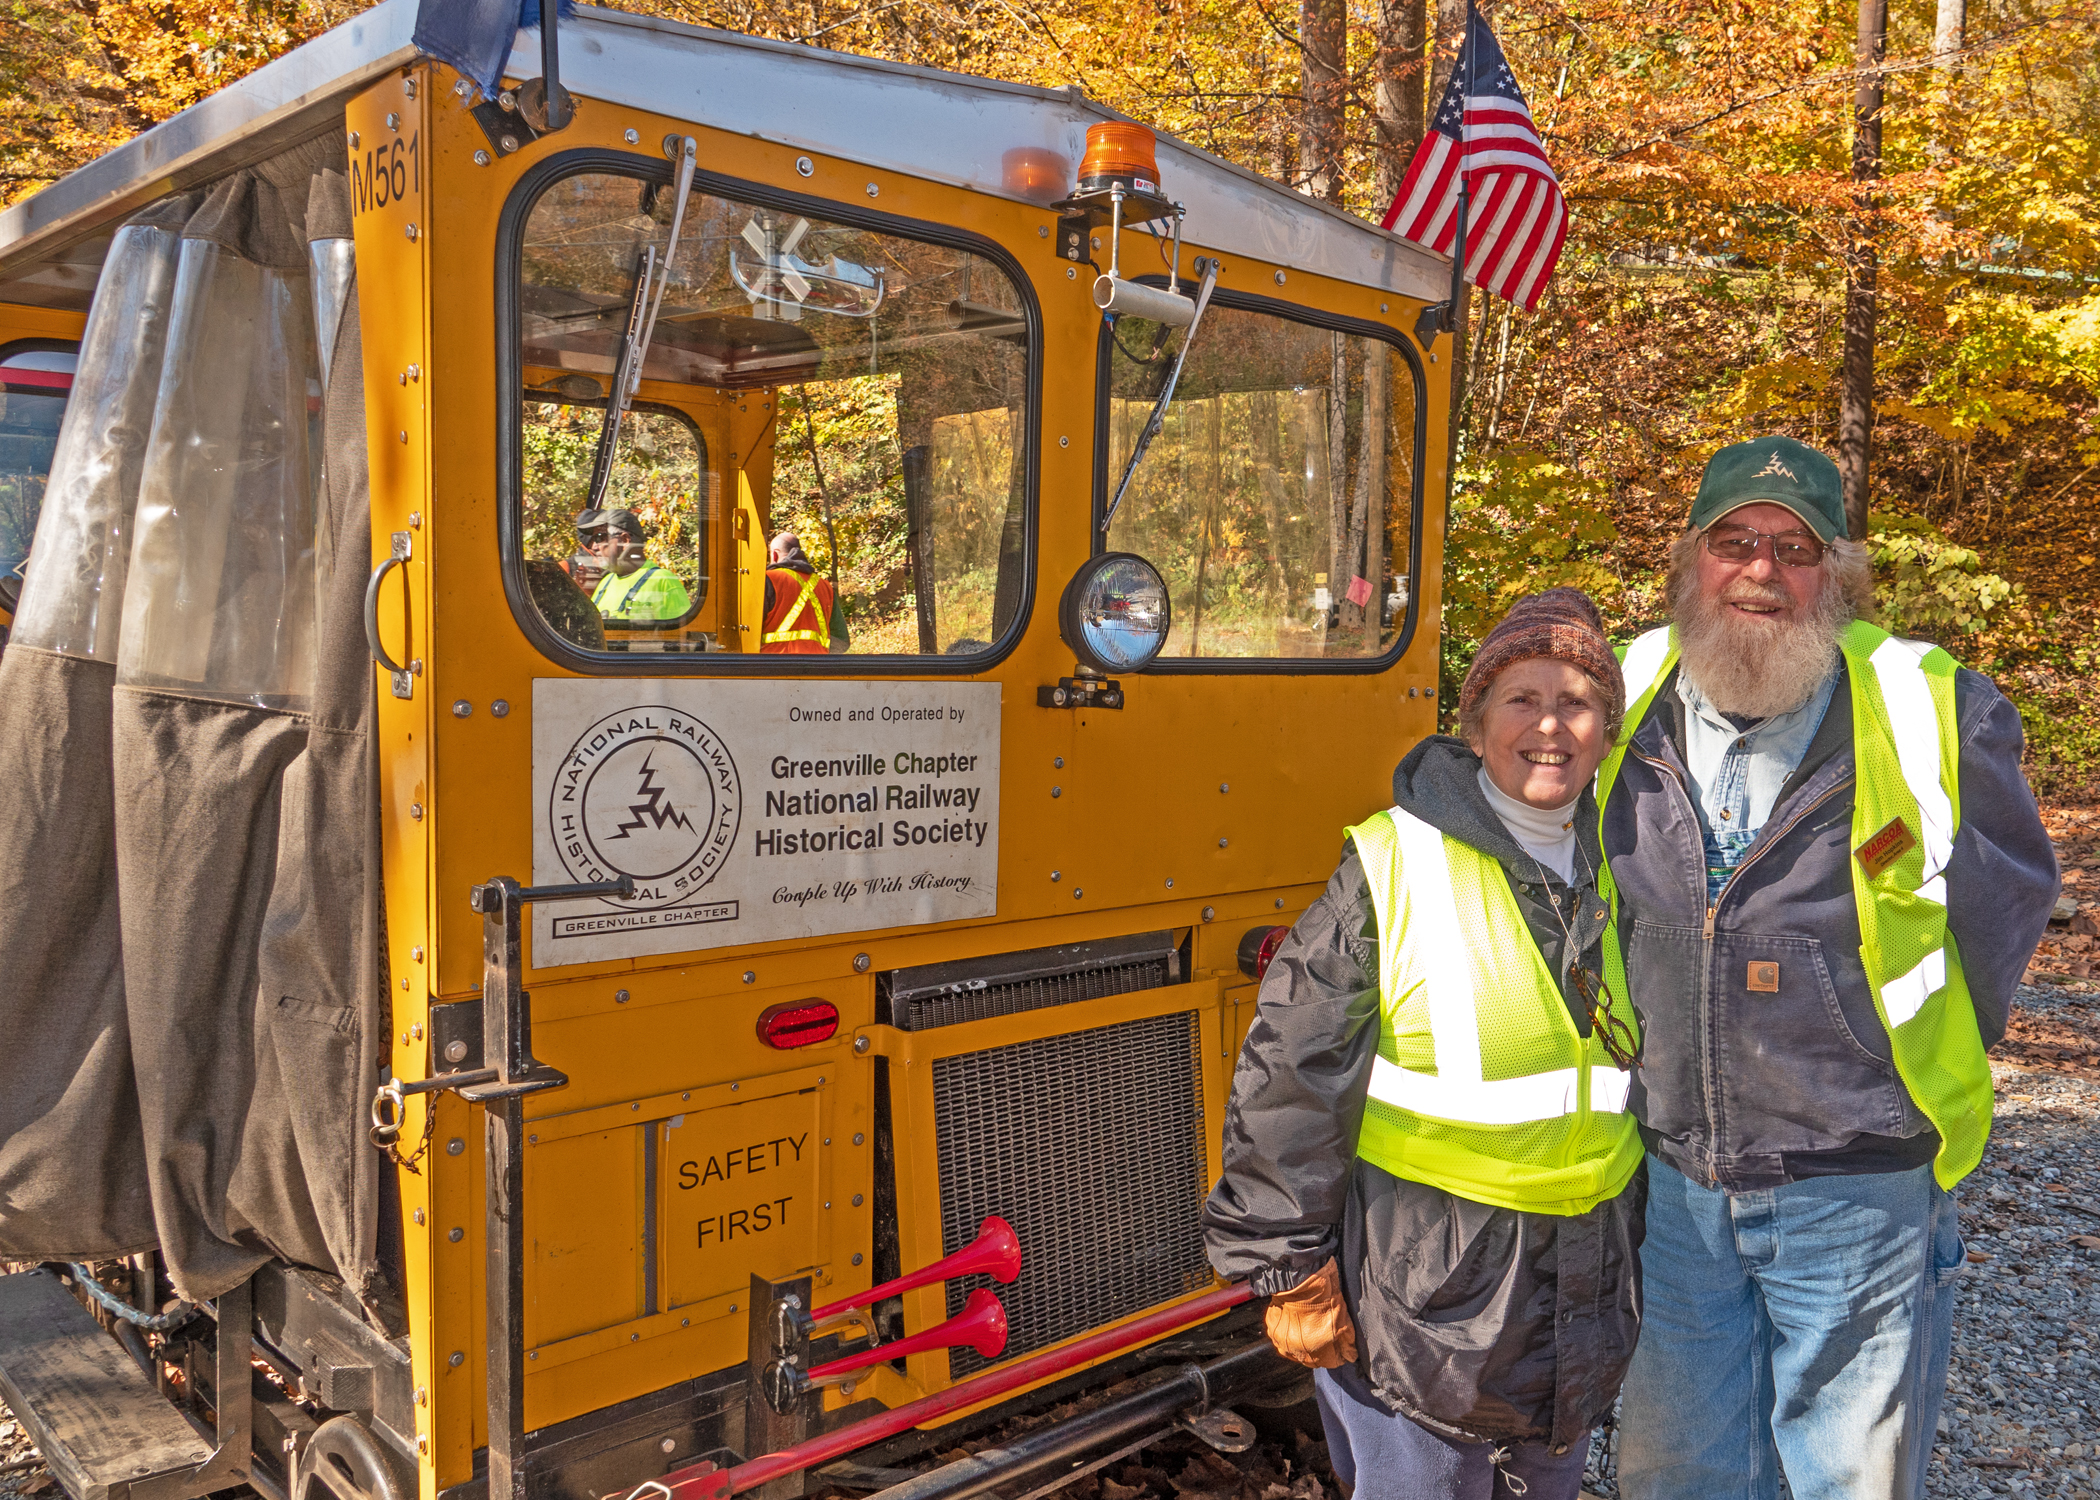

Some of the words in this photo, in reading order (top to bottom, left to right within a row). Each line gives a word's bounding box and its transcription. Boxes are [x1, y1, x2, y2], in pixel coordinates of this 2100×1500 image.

[353, 129, 419, 217] M561
[789, 706, 841, 722] Owned
[848, 706, 875, 722] and
[881, 706, 944, 724] Operated
[950, 706, 965, 723] by
[562, 717, 659, 802] NATIONAL
[669, 717, 734, 794] RAILWAY
[771, 753, 886, 779] Greenville
[893, 752, 978, 778] Chapter
[766, 785, 878, 818] National
[885, 783, 981, 813] Railway
[561, 814, 668, 901] HISTOAL
[674, 803, 733, 889] SOCIETY
[755, 822, 884, 857] Historical
[892, 818, 988, 847] Society
[1863, 823, 1904, 863] NARCOA
[832, 881, 858, 904] Up
[863, 876, 903, 895] With
[908, 870, 972, 893] History
[565, 915, 657, 932] GREENVILLE
[664, 907, 729, 922] CHAPTER
[678, 1132, 809, 1190] SAFETY
[698, 1196, 793, 1249] FIRST
